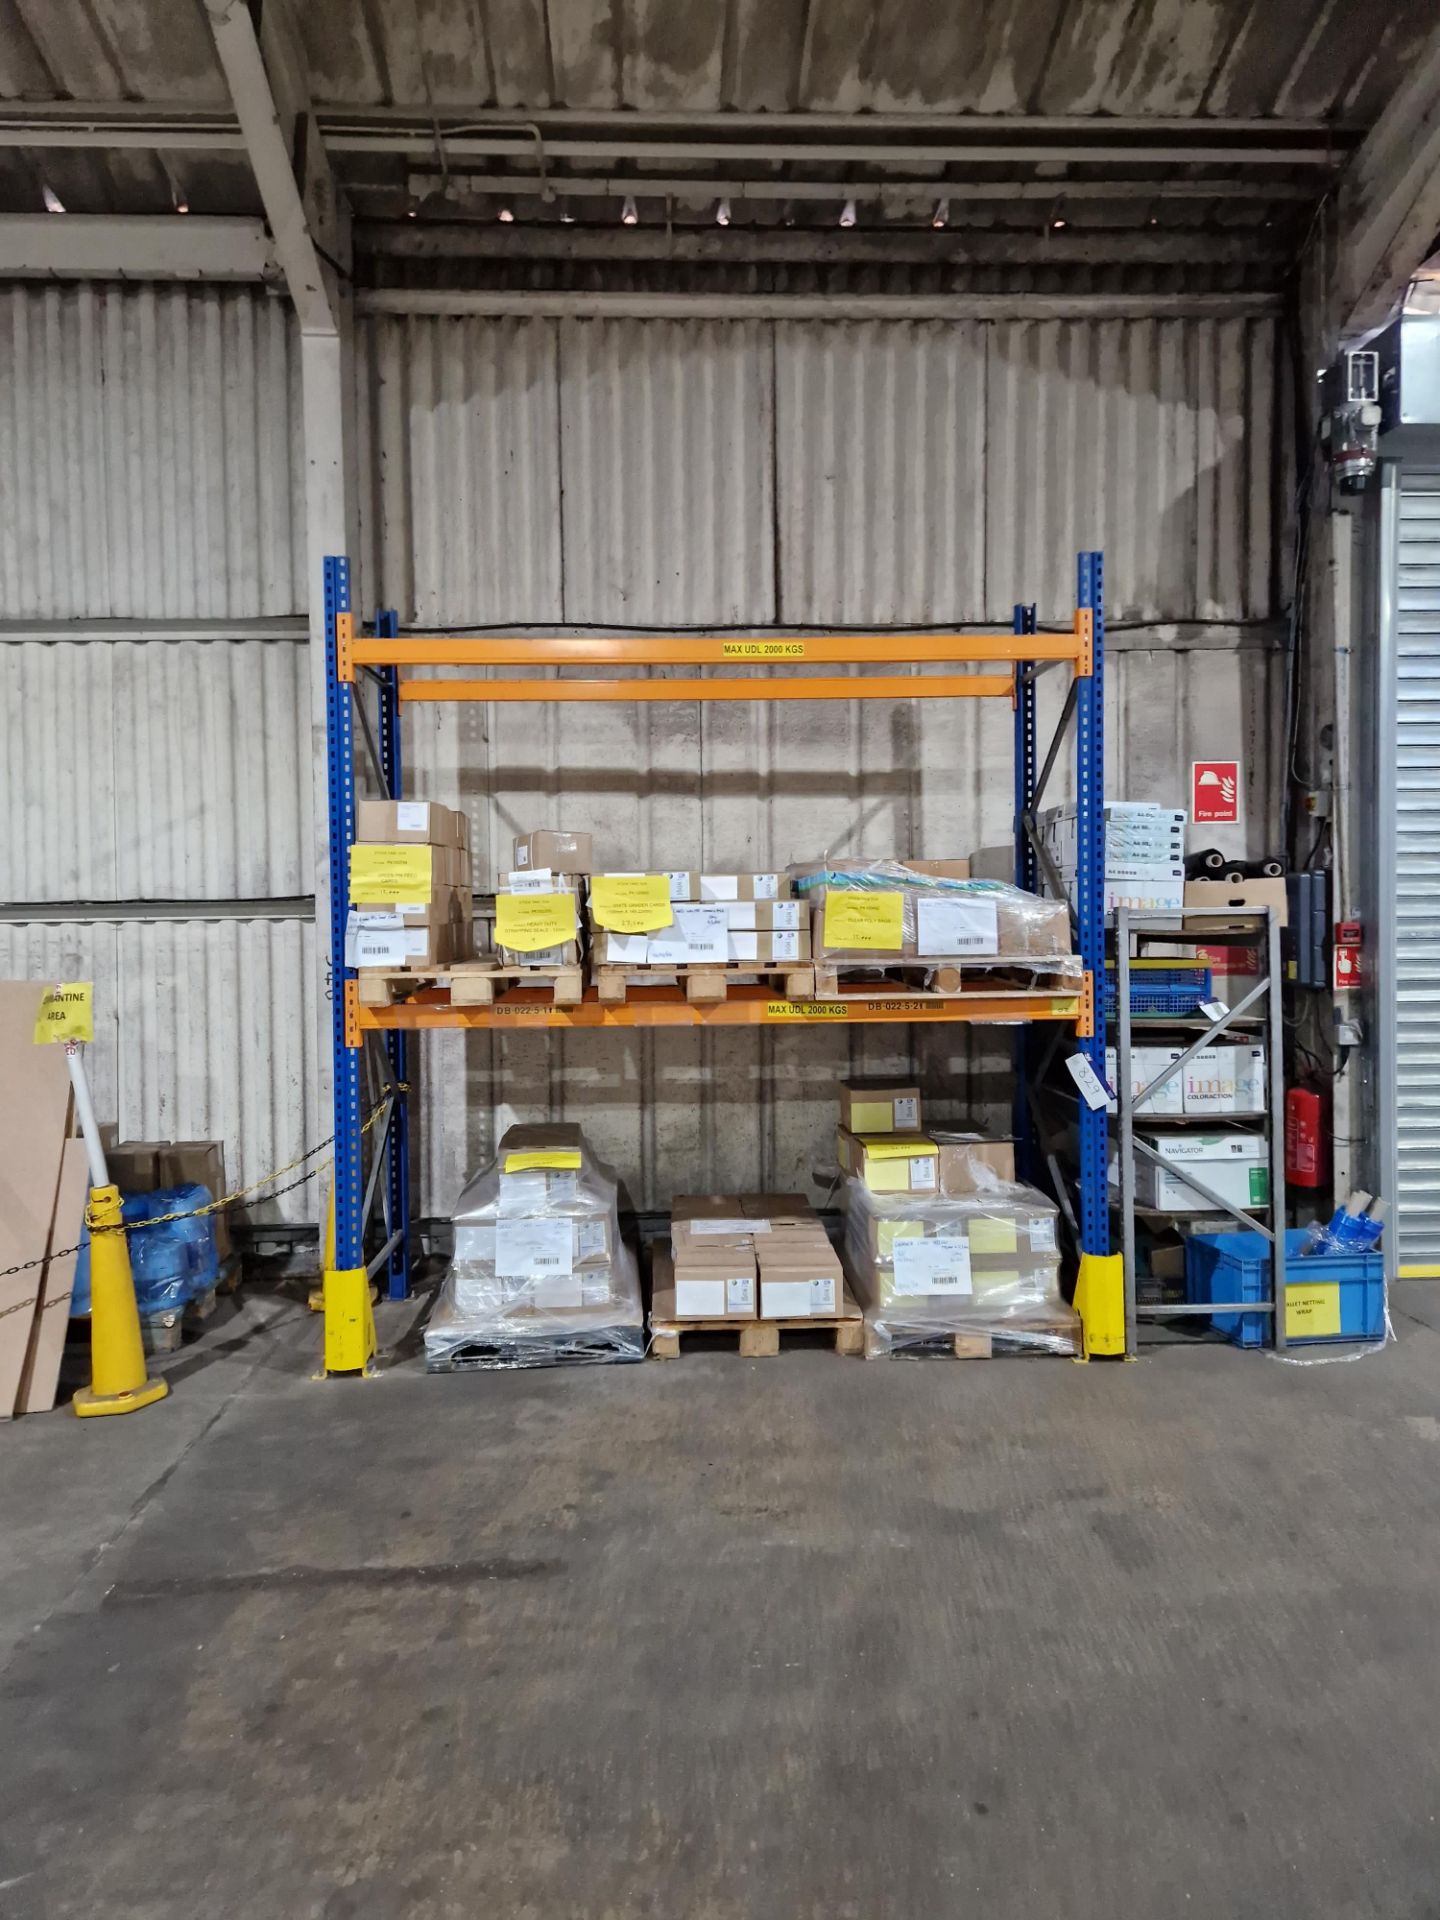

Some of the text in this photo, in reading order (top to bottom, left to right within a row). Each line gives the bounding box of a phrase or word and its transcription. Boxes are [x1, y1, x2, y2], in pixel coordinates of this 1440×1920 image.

[724, 644, 804, 654] MAX UDL 2000 KGS
[1214, 810, 1233, 818] point
[1109, 892, 1180, 910] image
[768, 1004, 847, 1015] MAX UDL 2000 KGS
[1187, 1076, 1260, 1098] image
[1187, 1093, 1233, 1101] COLORACTION
[1165, 1147, 1204, 1155] NAVIGATOR
